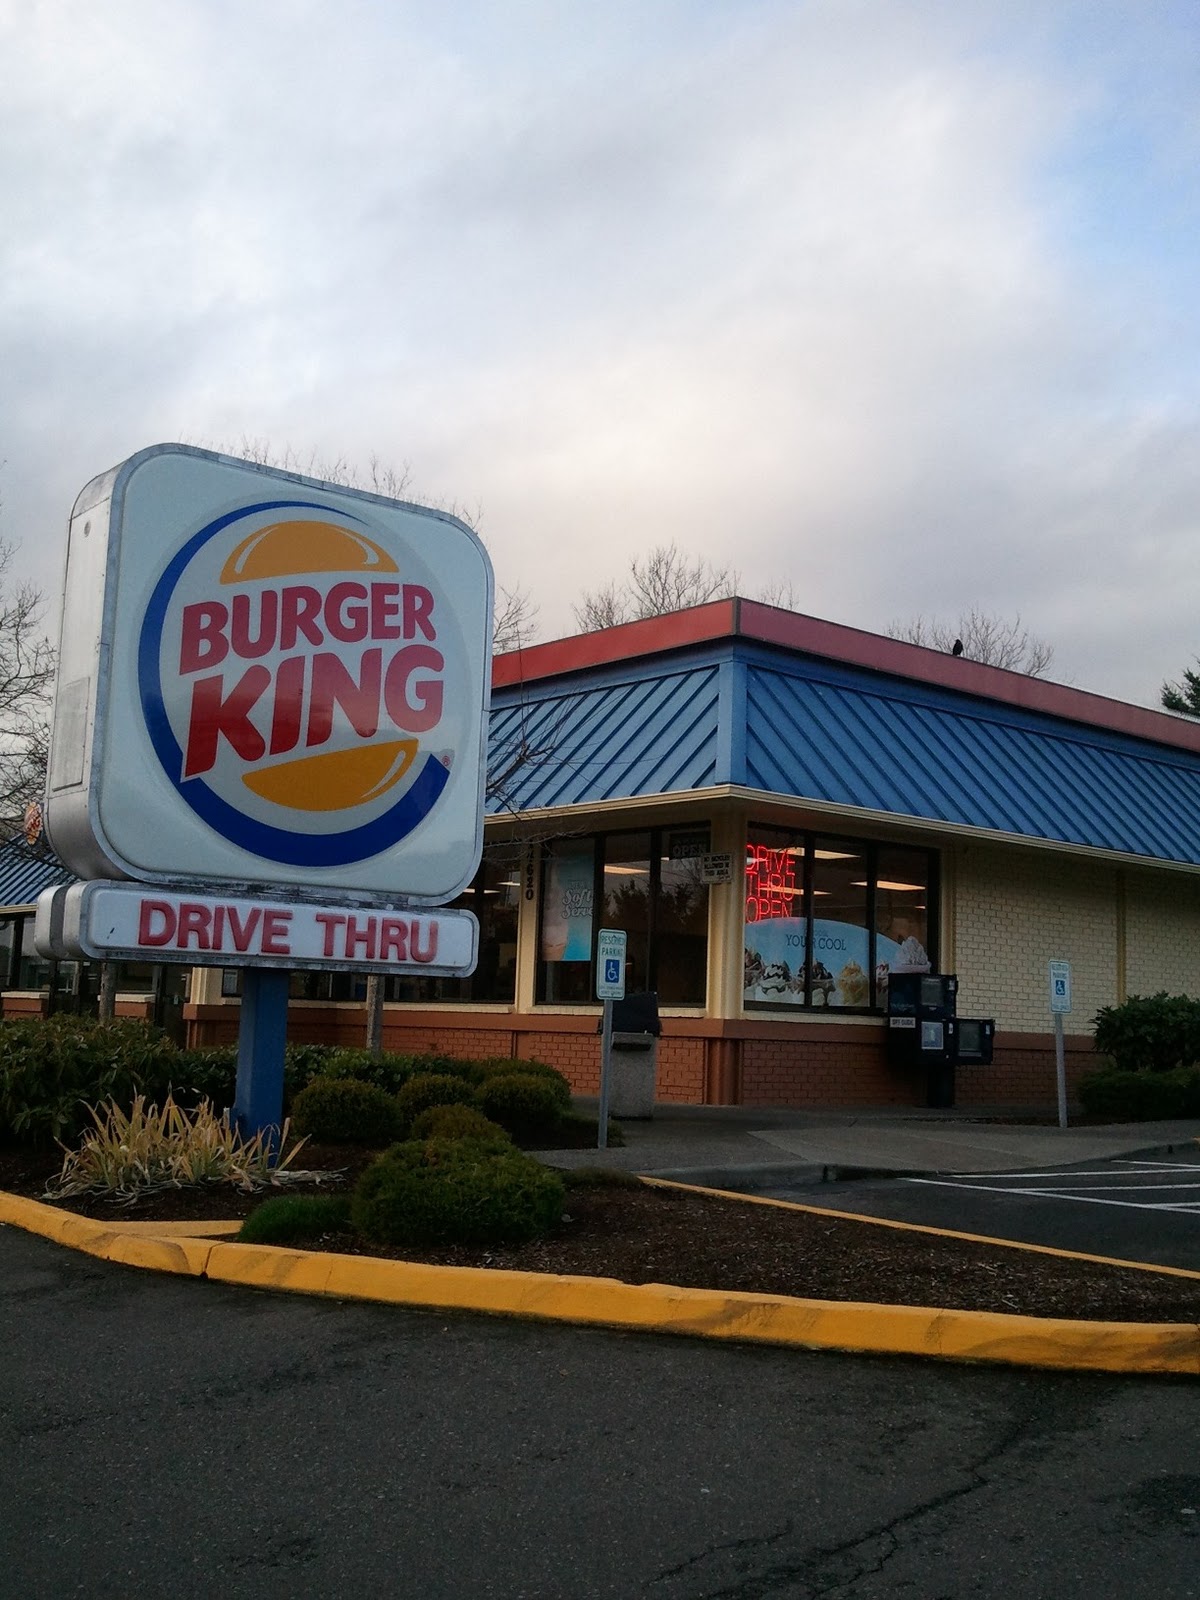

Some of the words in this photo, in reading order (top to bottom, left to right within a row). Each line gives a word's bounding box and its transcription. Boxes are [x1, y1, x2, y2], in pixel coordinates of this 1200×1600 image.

[179, 582, 437, 675] BURGER
[185, 644, 445, 777] KING
[745, 843, 796, 876] DRIVE
[562, 888, 592, 907] Soft
[745, 870, 795, 901] THRU
[745, 897, 792, 924] OPEN
[138, 899, 292, 955] DRIVE
[316, 913, 438, 963] THRU
[818, 938, 847, 950] COOL
